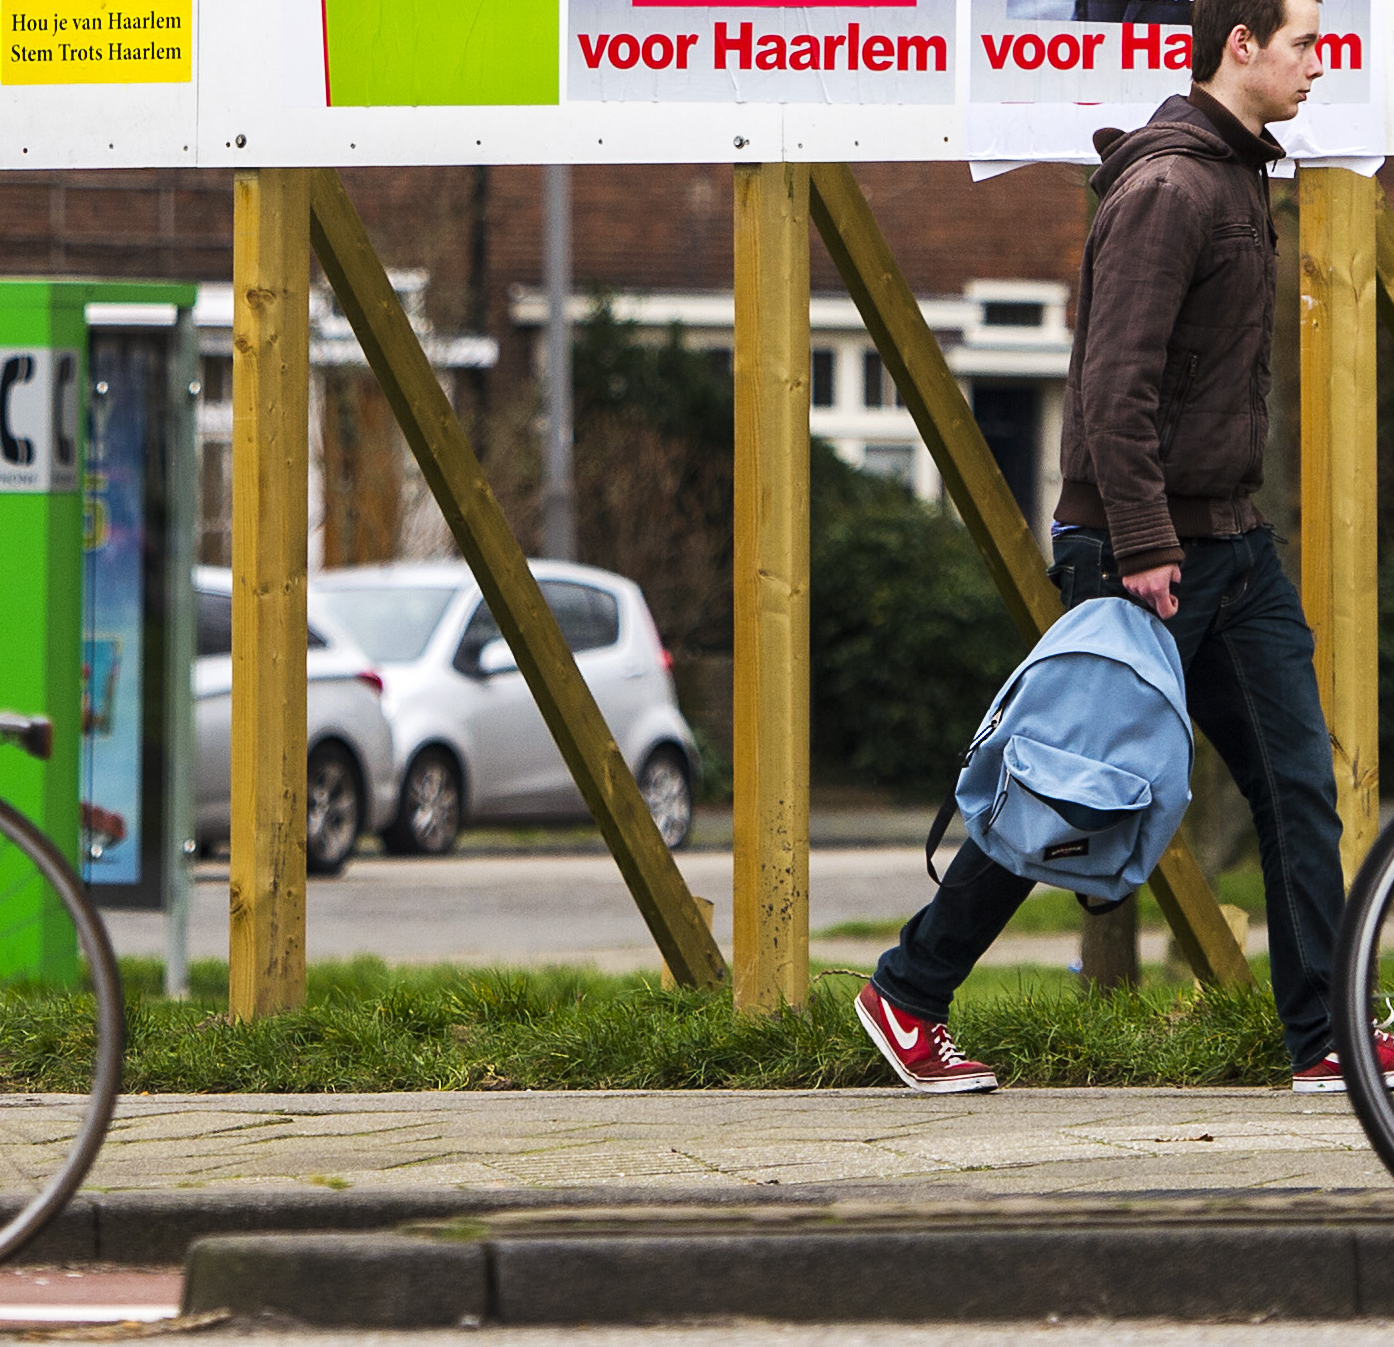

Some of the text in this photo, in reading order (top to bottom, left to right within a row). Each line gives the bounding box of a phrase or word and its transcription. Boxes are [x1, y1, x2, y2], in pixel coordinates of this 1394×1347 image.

[11, 10, 182, 37] Hou je van Haarlem
[11, 41, 182, 63] Stem Trots Haarlem
[577, 21, 949, 73] voor Haarlem
[979, 32, 1106, 72] voor
